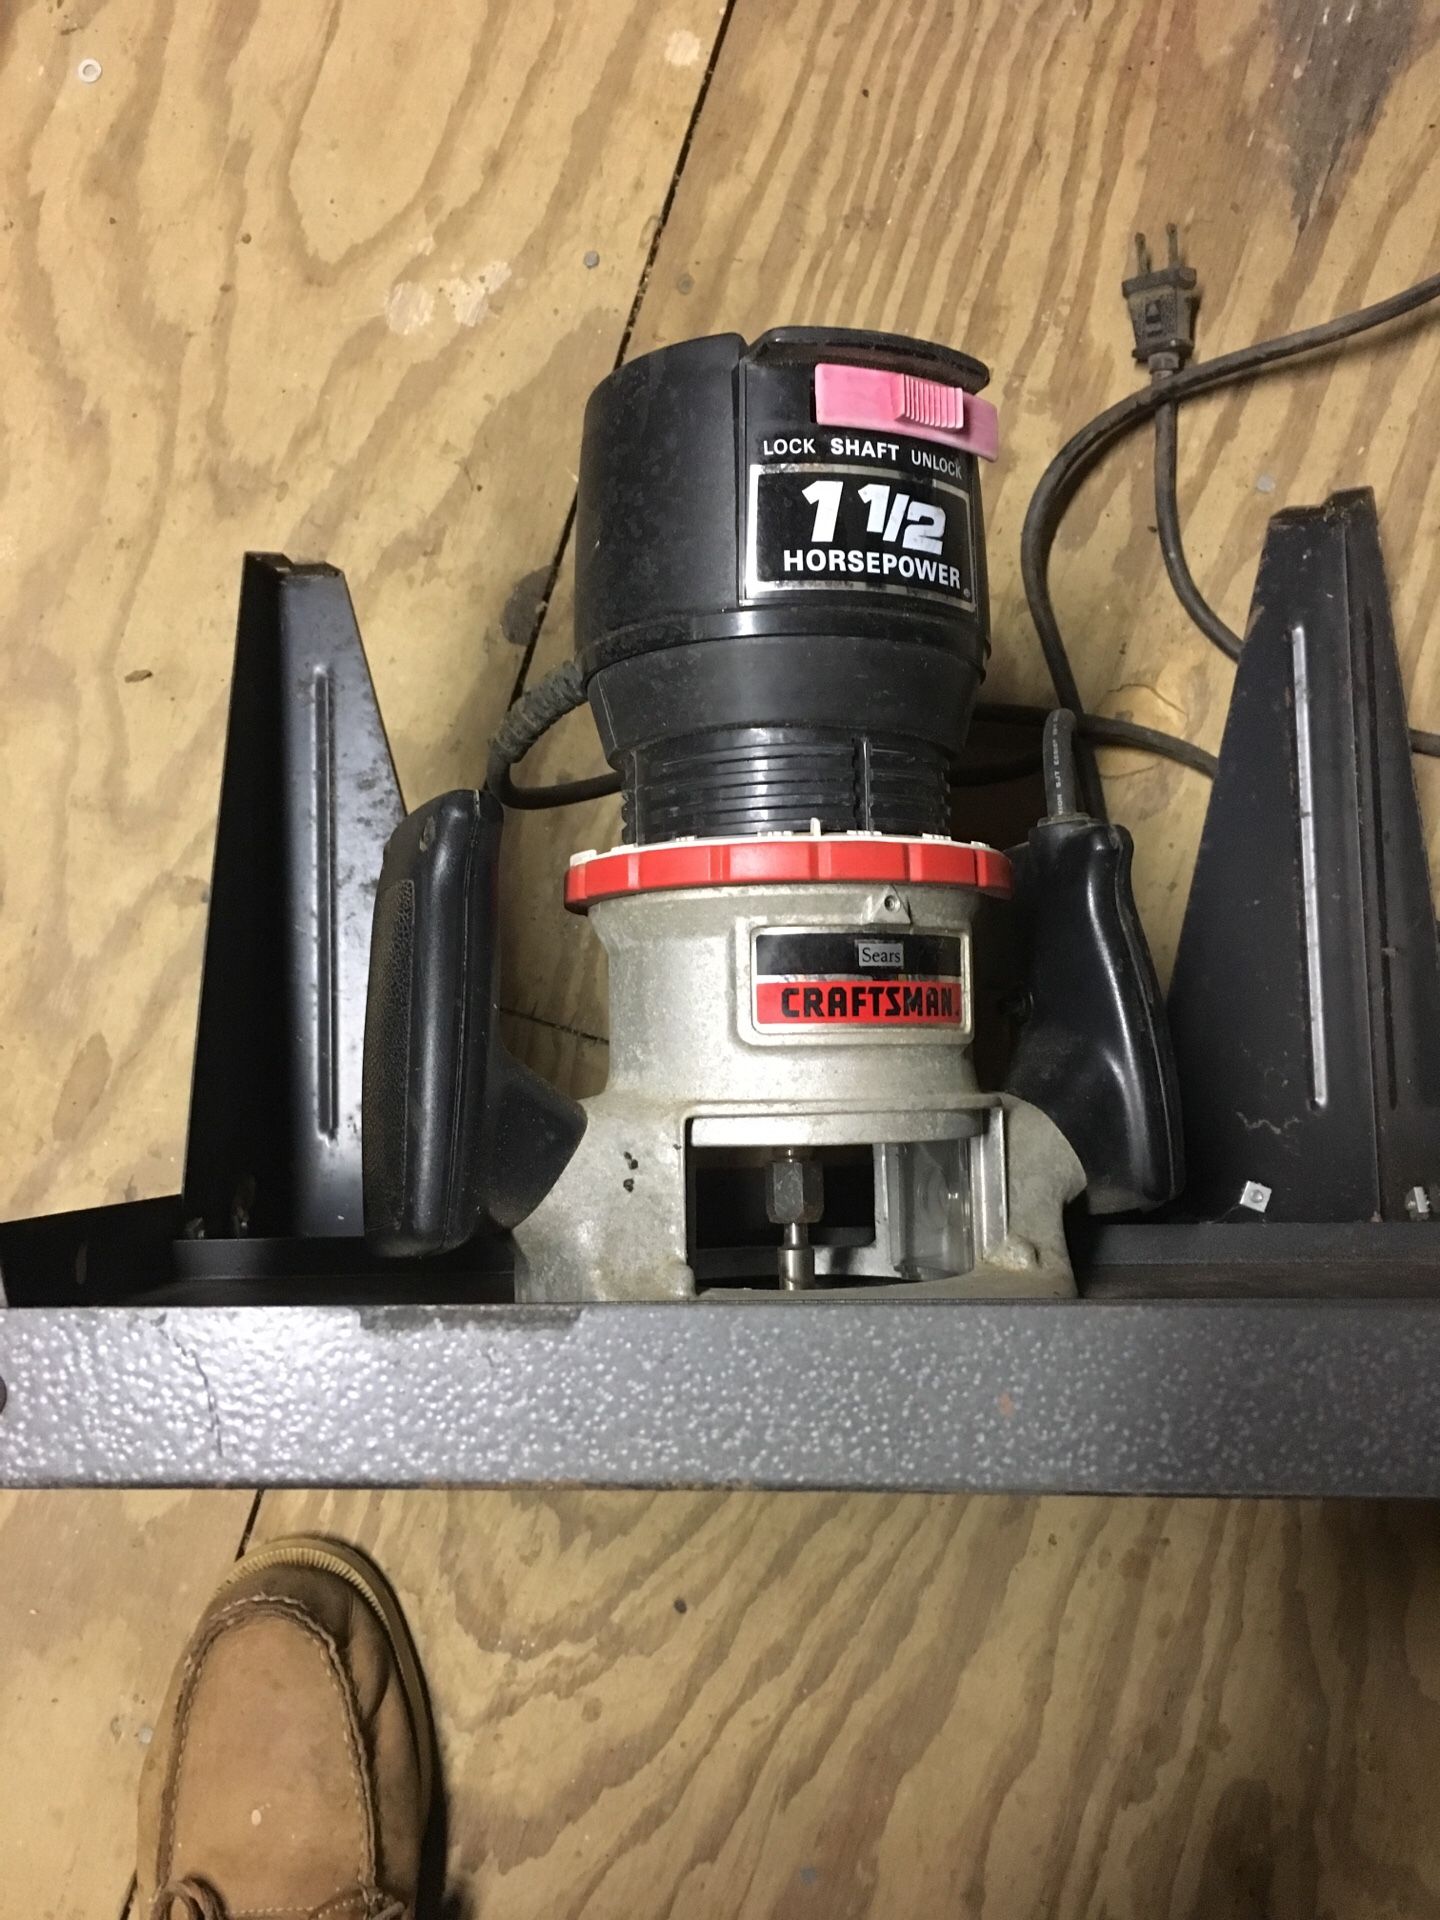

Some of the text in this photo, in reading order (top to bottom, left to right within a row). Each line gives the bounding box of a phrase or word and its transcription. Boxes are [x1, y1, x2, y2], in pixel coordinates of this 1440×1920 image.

[763, 438, 963, 479] LOCK SHAFT UNLOCK
[802, 480, 946, 555] 1 1/2
[783, 549, 961, 589] HORSEPOWER
[862, 947, 901, 962] Sears
[781, 986, 952, 1018] CRAFTSMAN
